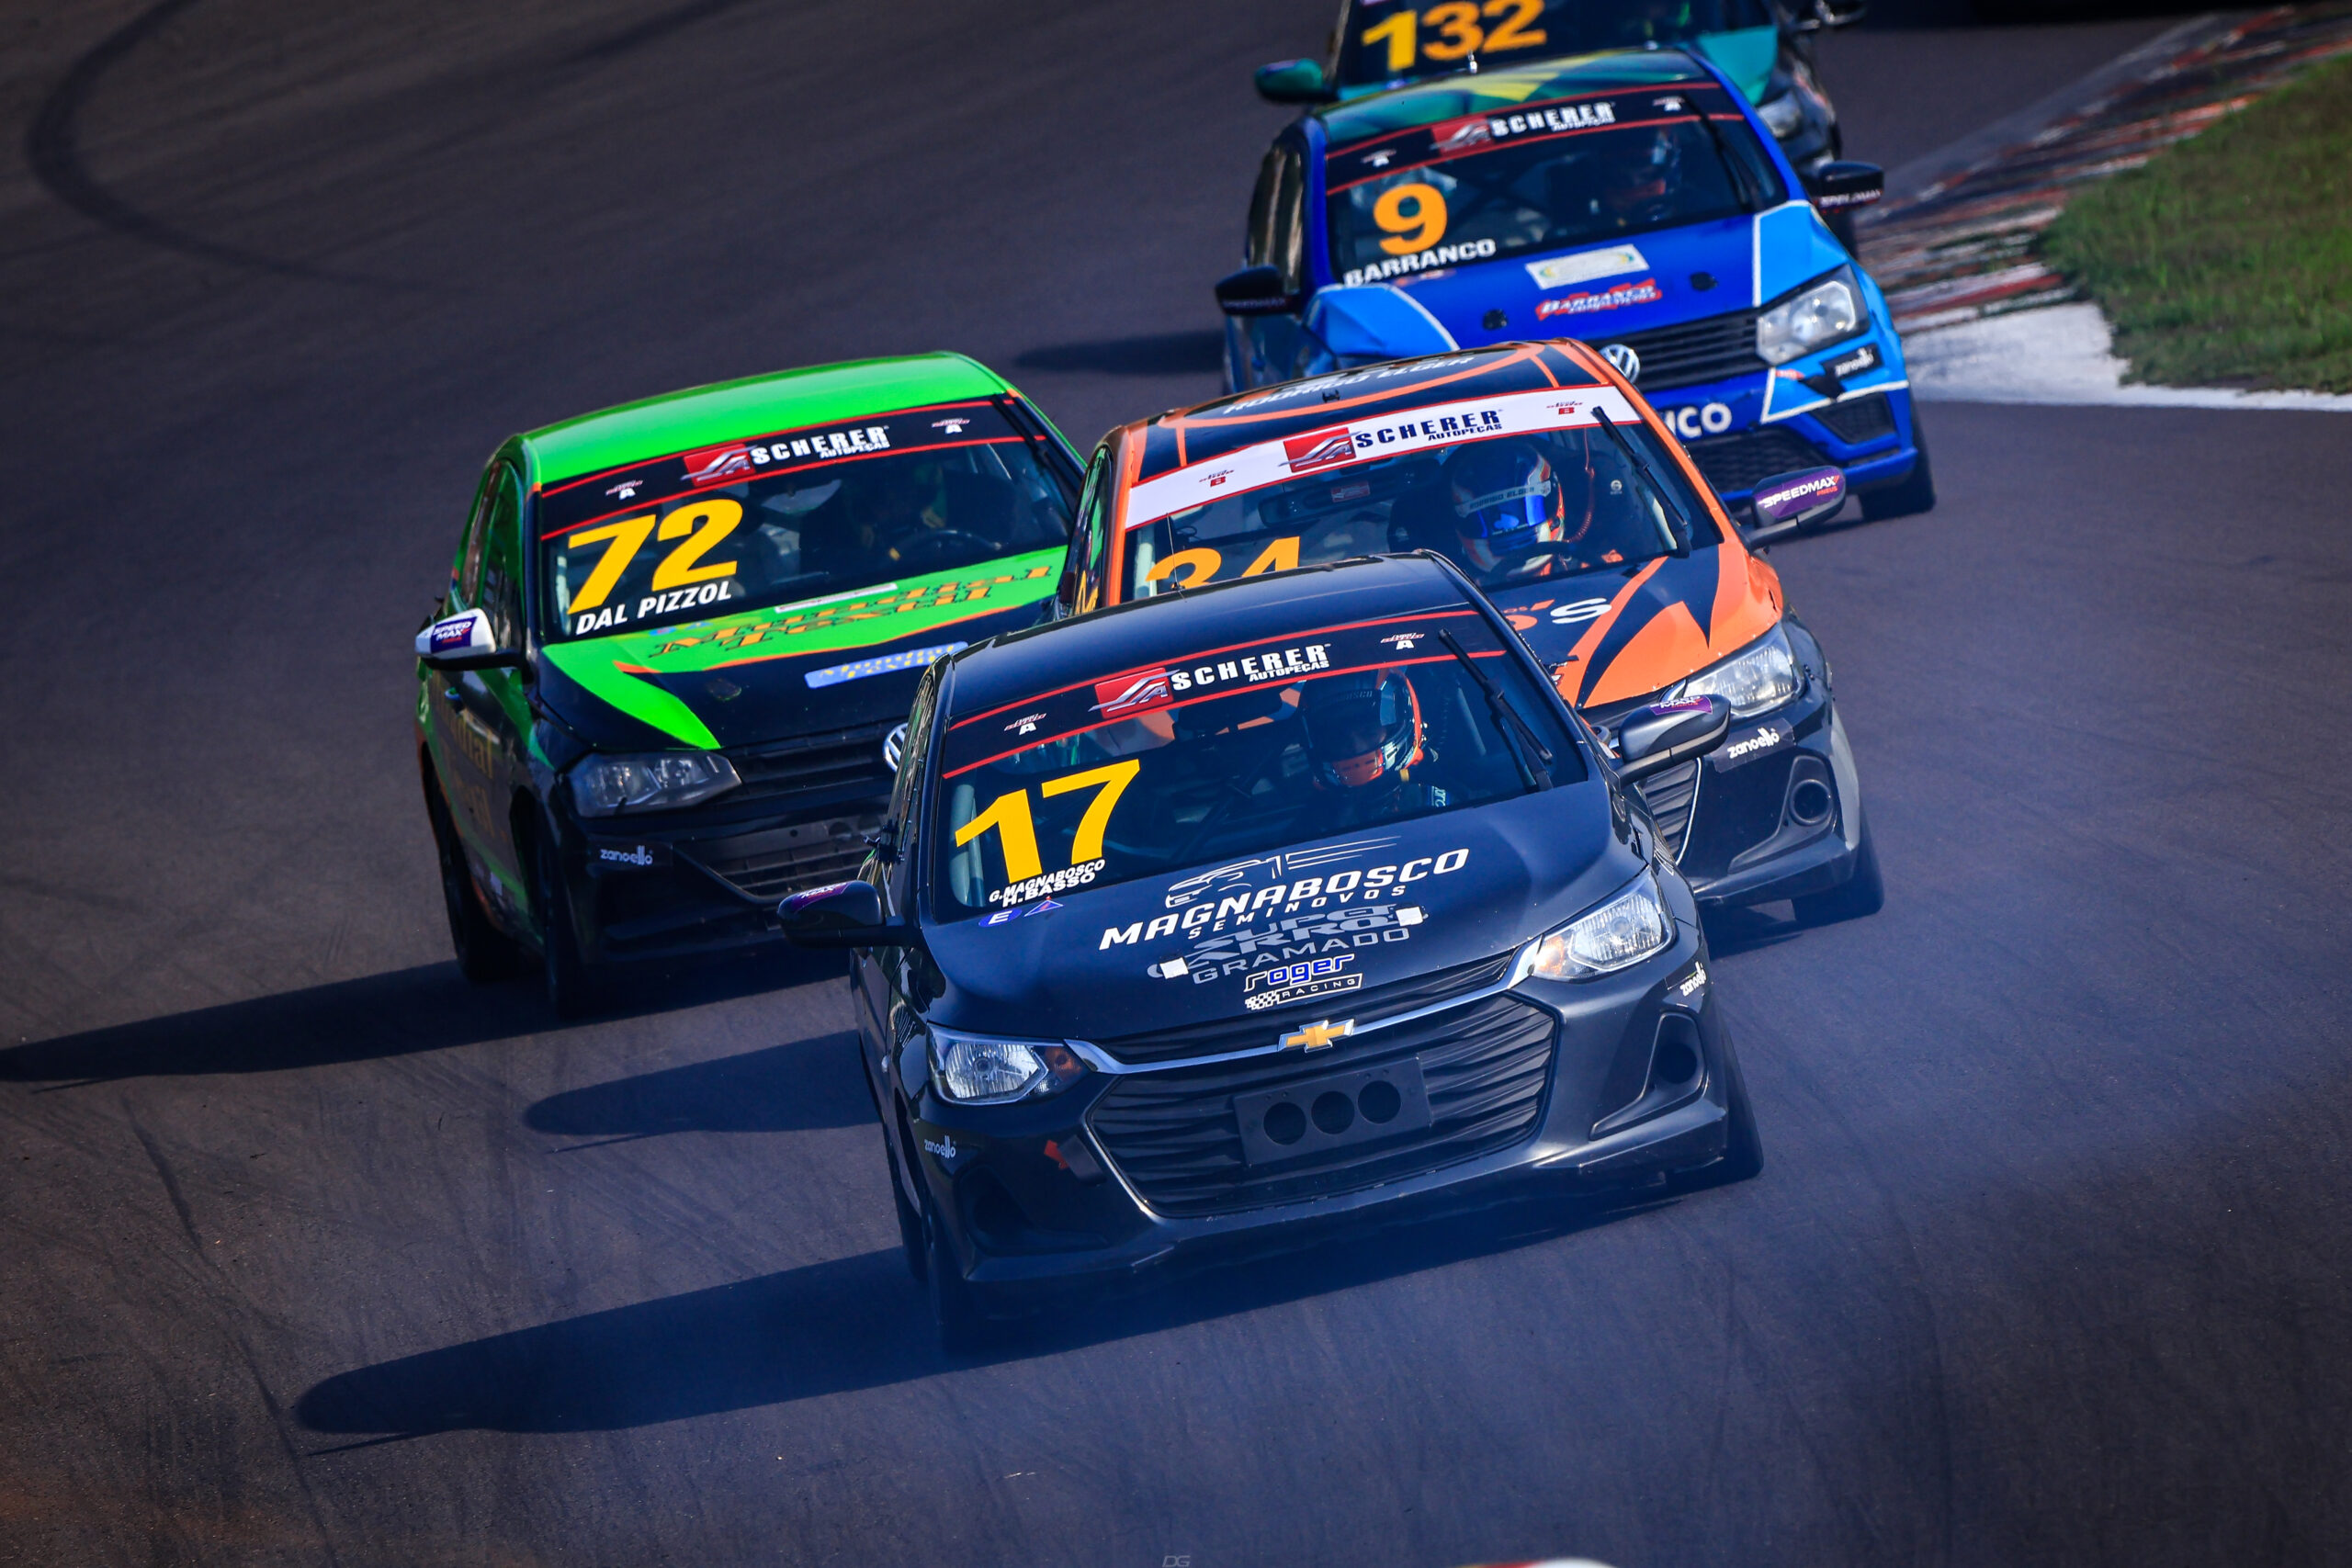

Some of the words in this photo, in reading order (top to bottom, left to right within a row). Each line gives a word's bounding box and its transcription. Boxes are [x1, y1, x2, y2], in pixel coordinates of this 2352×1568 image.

[1362, 0, 1548, 72] 132
[1490, 101, 1614, 137] SCHERER
[1373, 183, 1448, 255] 9
[1342, 238, 1497, 288] BARRANCO
[750, 425, 888, 466] SCHERER
[1355, 410, 1501, 448] SCHERER
[1758, 476, 1837, 509] SPEEDMAX
[567, 499, 743, 615] 72
[575, 604, 628, 636] DAL
[636, 581, 732, 619] PIZZOL
[435, 629, 463, 641] MAX
[1170, 644, 1329, 692] SCHERER
[1249, 660, 1329, 682] AUTOPEÇAS
[1726, 727, 1781, 759] zanoello
[955, 758, 1140, 884] 17
[600, 845, 653, 865] zanoello
[989, 859, 1105, 903] G.MAGNABOSCO
[1002, 873, 1095, 908] H.BASSO
[1099, 848, 1470, 951] MAGNABOSCO
[1188, 885, 1408, 940] SEMINOVOS
[1193, 927, 1410, 985] GRAMADO
[1244, 953, 1355, 993] roger
[1282, 978, 1356, 998] RACING
[924, 1134, 956, 1159] zanoello
